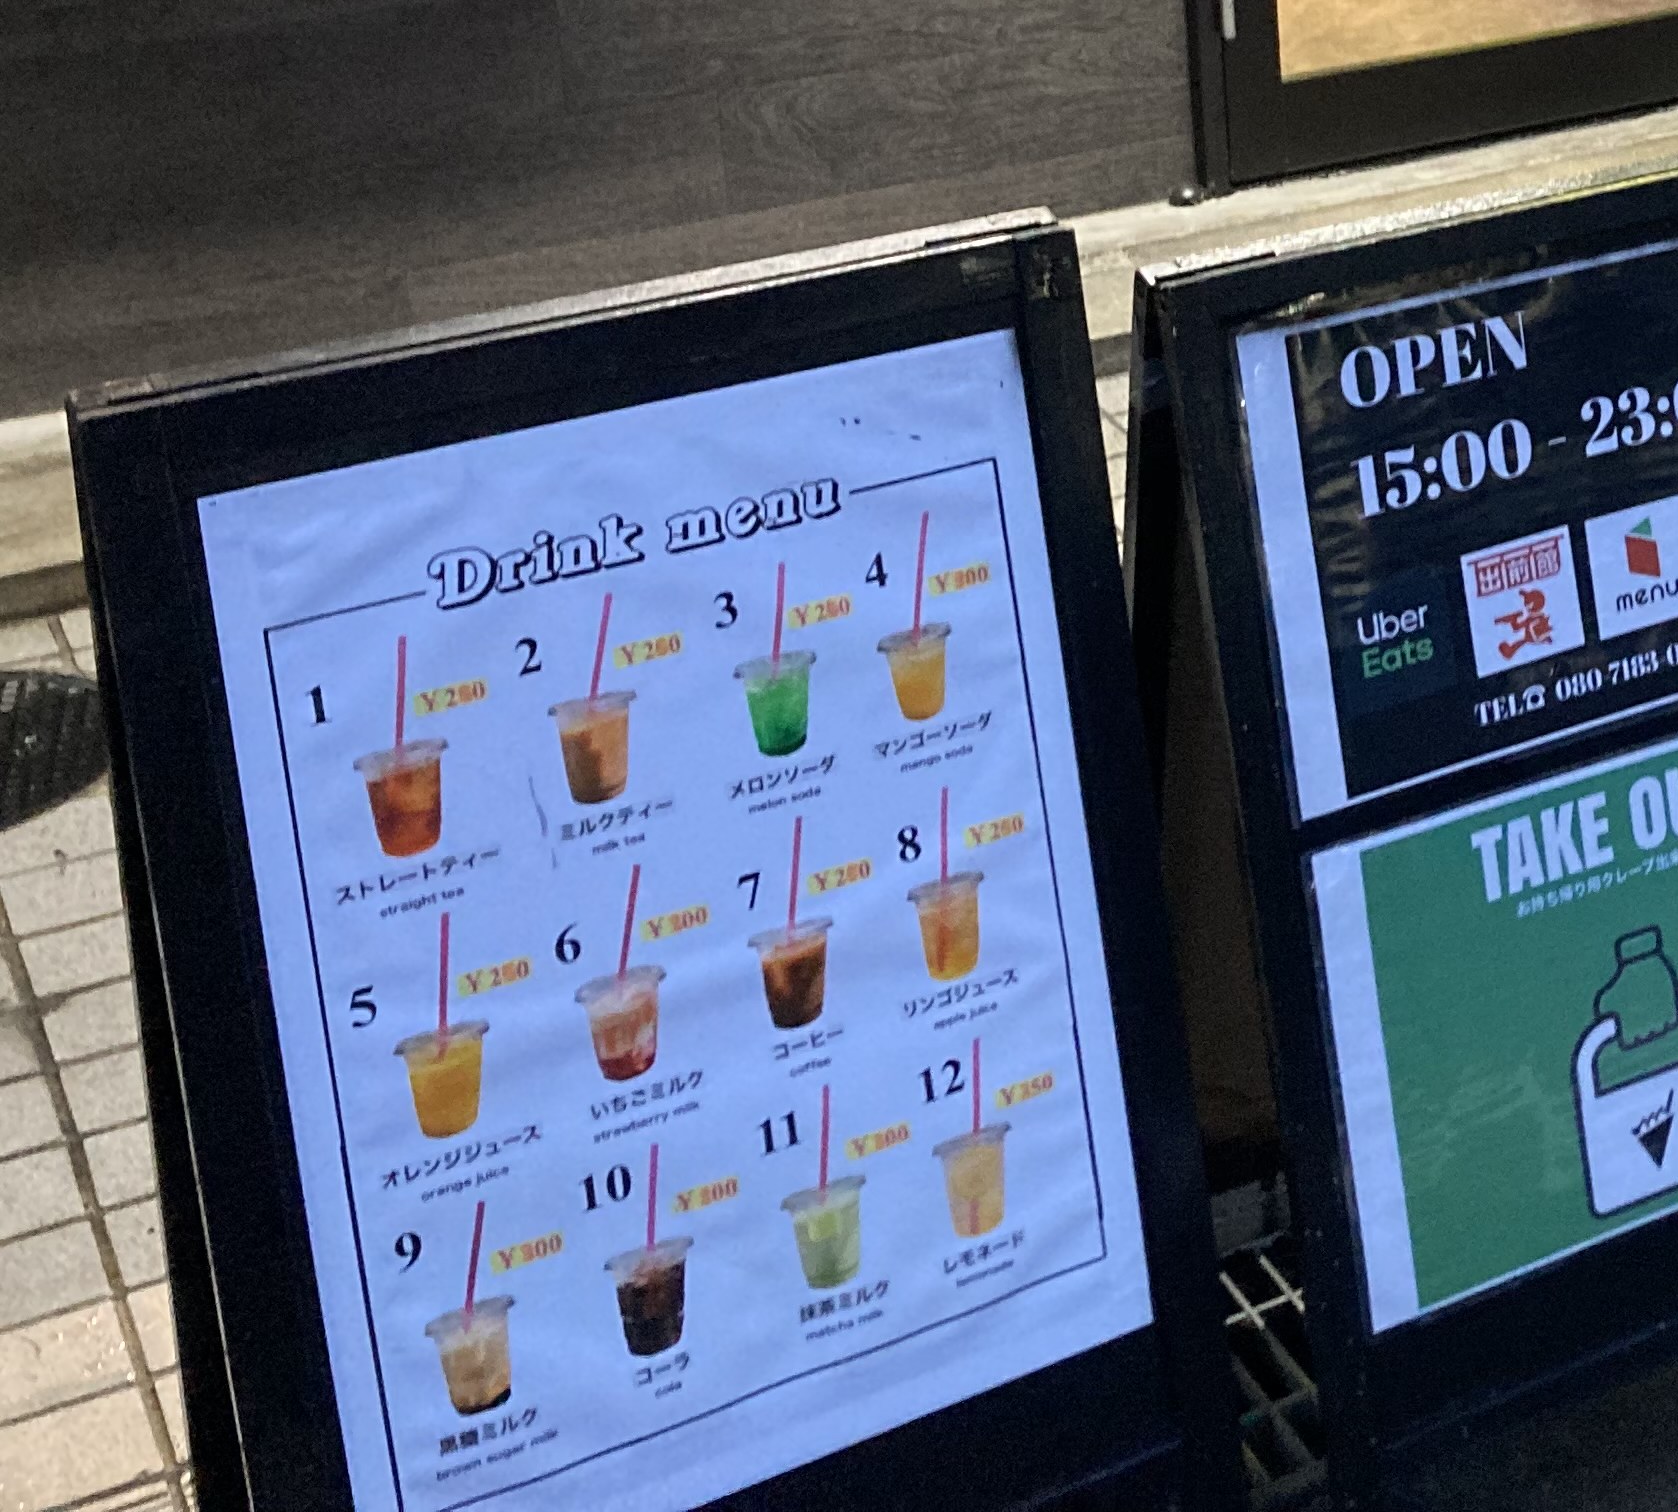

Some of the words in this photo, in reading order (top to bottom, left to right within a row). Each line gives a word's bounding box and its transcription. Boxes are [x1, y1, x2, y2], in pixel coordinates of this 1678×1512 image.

[1339, 311, 1529, 408] OPEN
[1350, 417, 1533, 521] 15:00
[427, 513, 645, 610] Drink
[665, 477, 841, 554] menu
[865, 552, 889, 588] 4
[1478, 541, 1561, 597] 出前館
[713, 591, 738, 629] 3
[1357, 603, 1428, 646] Uber
[515, 637, 543, 677] 2
[1362, 636, 1434, 679] Eats
[305, 684, 332, 726] 1
[874, 711, 992, 758] マンゴーソーダ
[731, 754, 837, 799] メロンソーダ
[900, 753, 942, 773] mango
[945, 744, 973, 761] soda
[561, 800, 674, 843] ミルクティー
[748, 795, 786, 814] melon
[791, 786, 821, 803] soda
[897, 824, 922, 863] 8
[1471, 791, 1614, 904] TAKE
[336, 849, 499, 905] ストレートティー
[737, 872, 761, 911] 7
[379, 892, 438, 919] straight
[441, 887, 464, 903] tea
[554, 922, 582, 963] 6
[349, 985, 378, 1028] 5
[903, 969, 1018, 1018] リンゴジュース
[772, 1029, 844, 1061] コーヒー
[590, 1069, 704, 1121] いちごミルク
[917, 1058, 966, 1104] 12
[593, 1111, 669, 1144] strawberry
[759, 1110, 801, 1157] 11
[381, 1125, 543, 1189] オレンジジュース
[421, 1178, 473, 1202] orange
[476, 1165, 510, 1187] juice
[580, 1164, 633, 1213] 10
[393, 1231, 423, 1273] 9
[943, 1228, 1025, 1274] レモネード
[635, 1351, 690, 1386] コーラ
